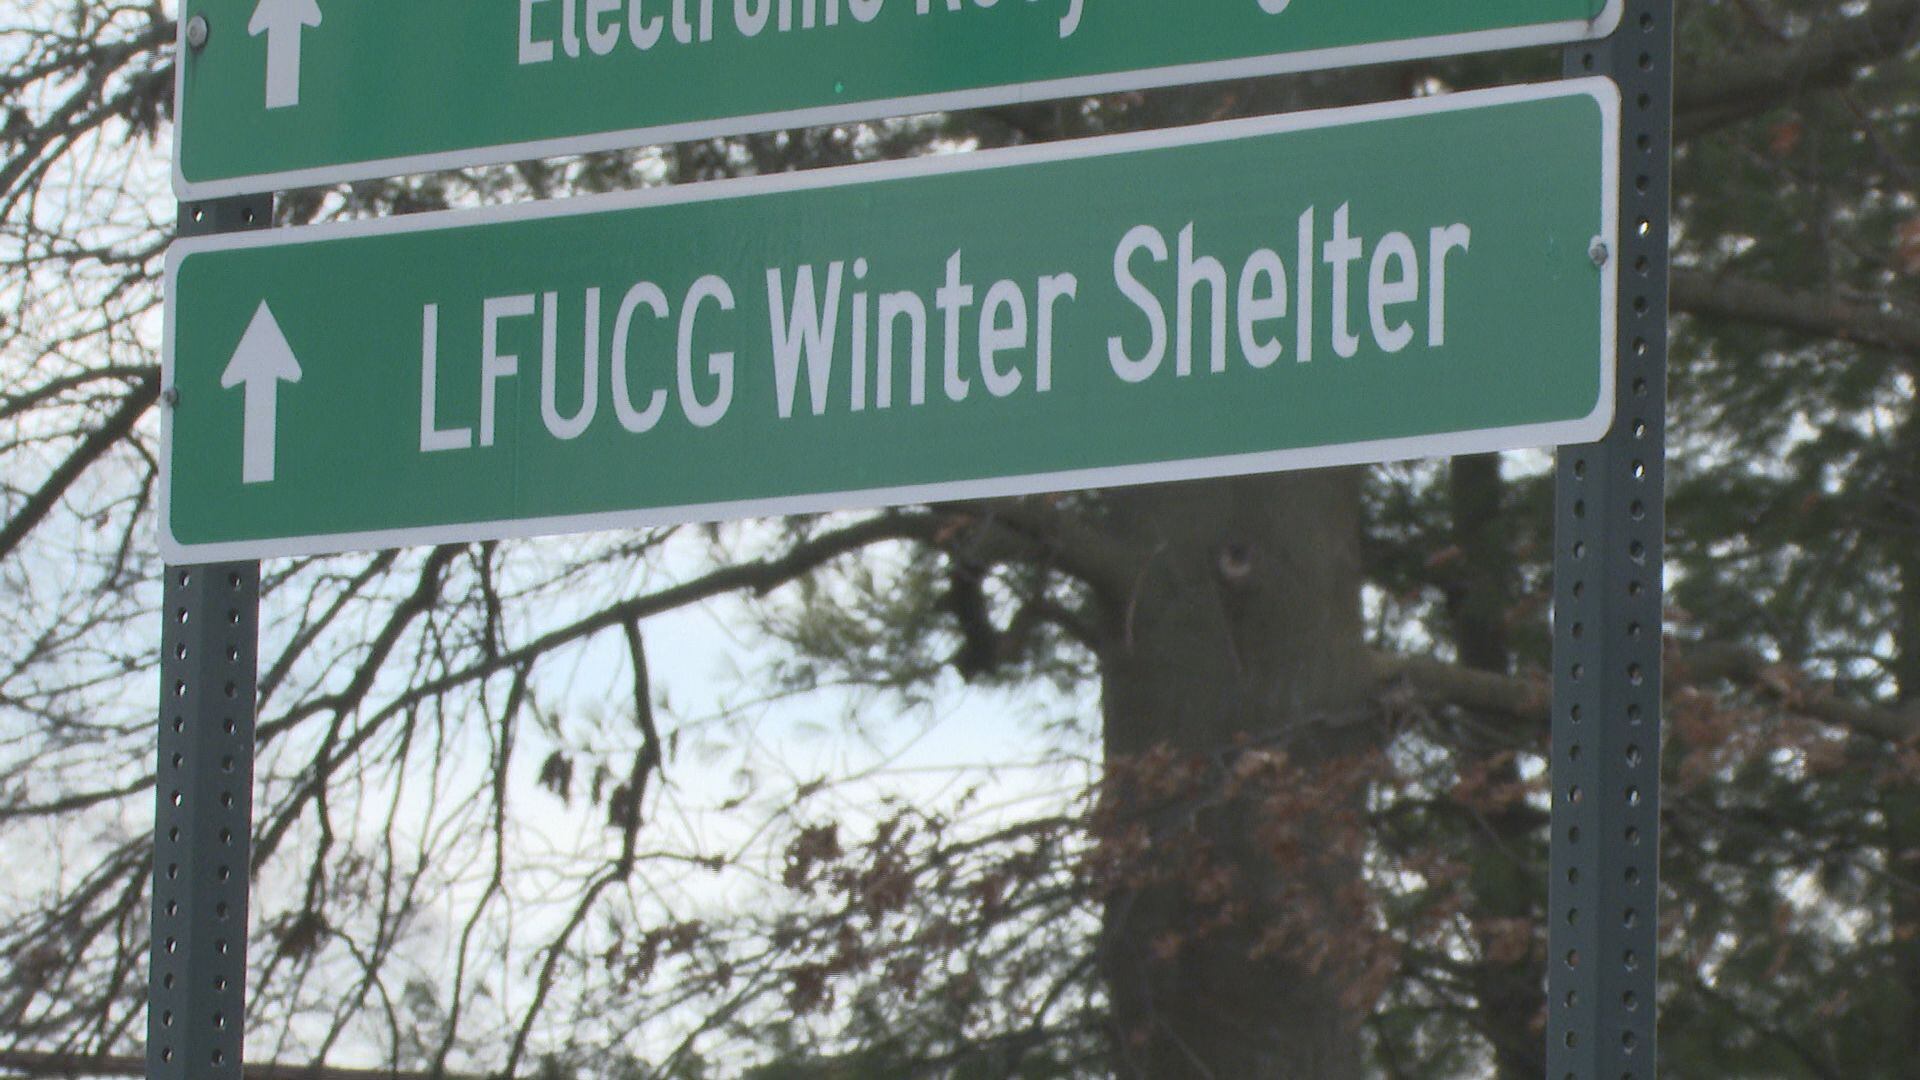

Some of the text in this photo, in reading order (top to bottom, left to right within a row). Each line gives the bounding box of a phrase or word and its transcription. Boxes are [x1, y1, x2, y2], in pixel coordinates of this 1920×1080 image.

[419, 200, 1472, 455] LFUCG Winter Shelter
